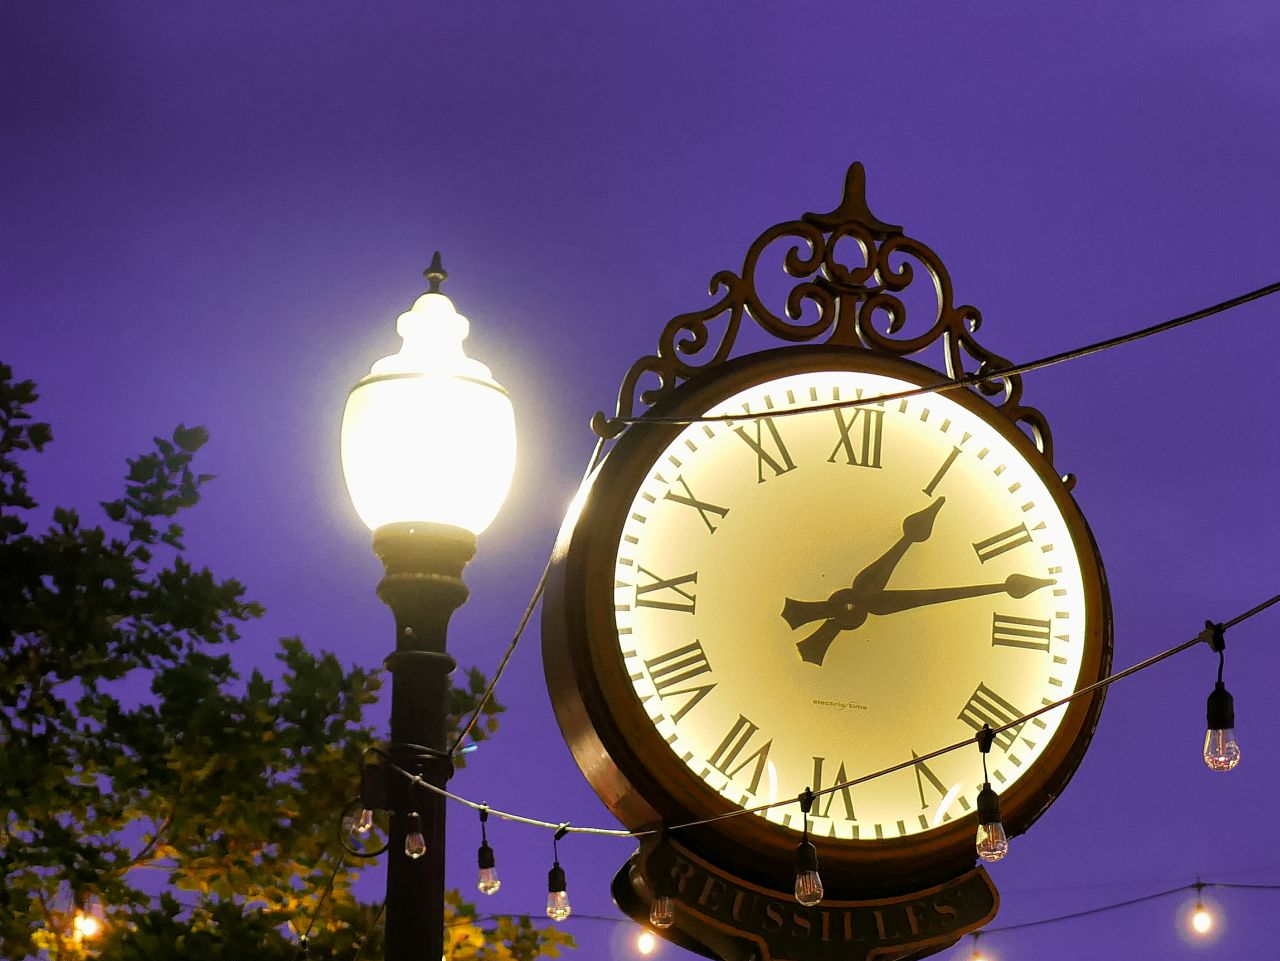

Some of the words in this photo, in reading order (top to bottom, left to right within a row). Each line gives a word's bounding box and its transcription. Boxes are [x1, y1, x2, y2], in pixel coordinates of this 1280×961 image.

[735, 416, 798, 484] XI
[827, 406, 885, 470] XII
[922, 444, 963, 497] I
[663, 475, 730, 535] X
[972, 522, 1033, 564] II
[635, 565, 698, 615] IX
[992, 612, 1051, 653] III
[644, 639, 719, 726] VIII
[706, 713, 774, 797] VII
[911, 749, 954, 809] V
[810, 756, 858, 822] VI
